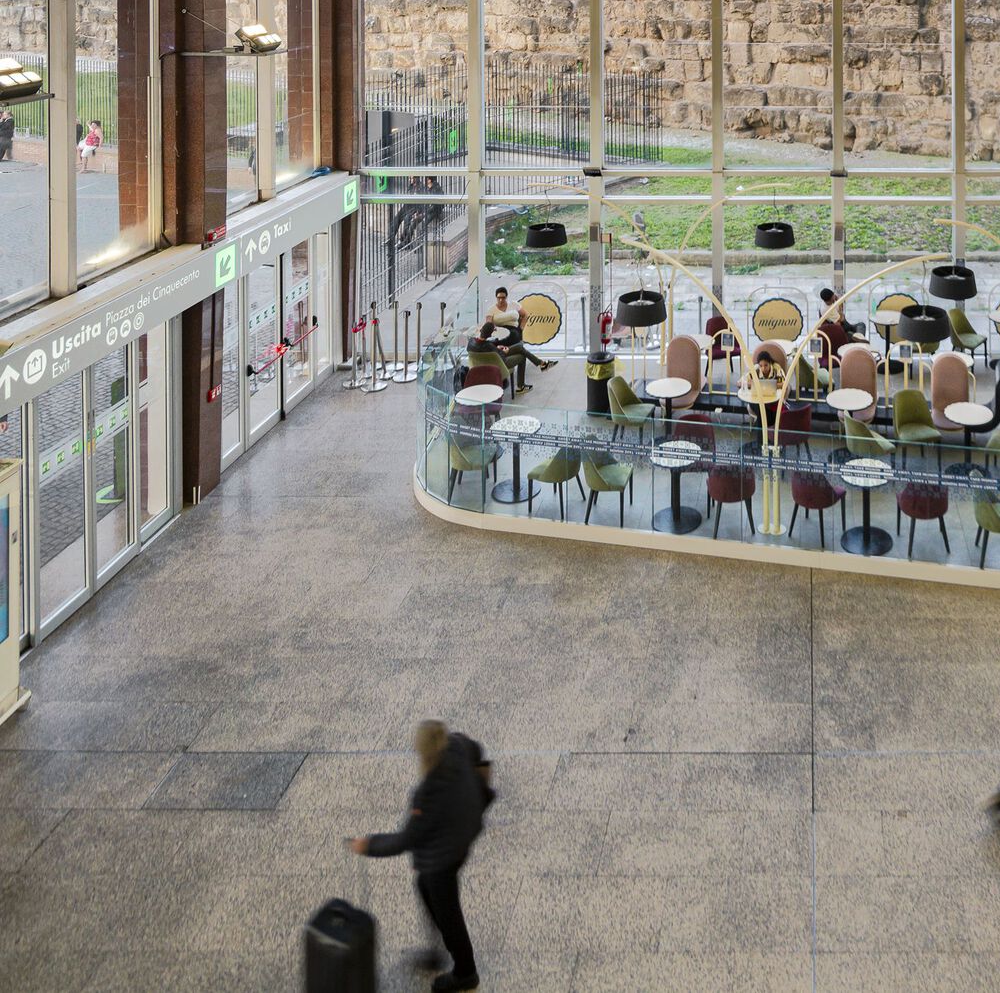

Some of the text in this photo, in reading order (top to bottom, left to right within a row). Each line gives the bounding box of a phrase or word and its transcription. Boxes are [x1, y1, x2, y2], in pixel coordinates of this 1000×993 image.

[273, 217, 292, 239] Taxi
[105, 270, 200, 327] Piazza dei Cinquecento
[526, 312, 556, 327] ignon
[758, 317, 798, 331] mignon
[52, 321, 102, 359] Uscita
[52, 358, 71, 379] Exit
